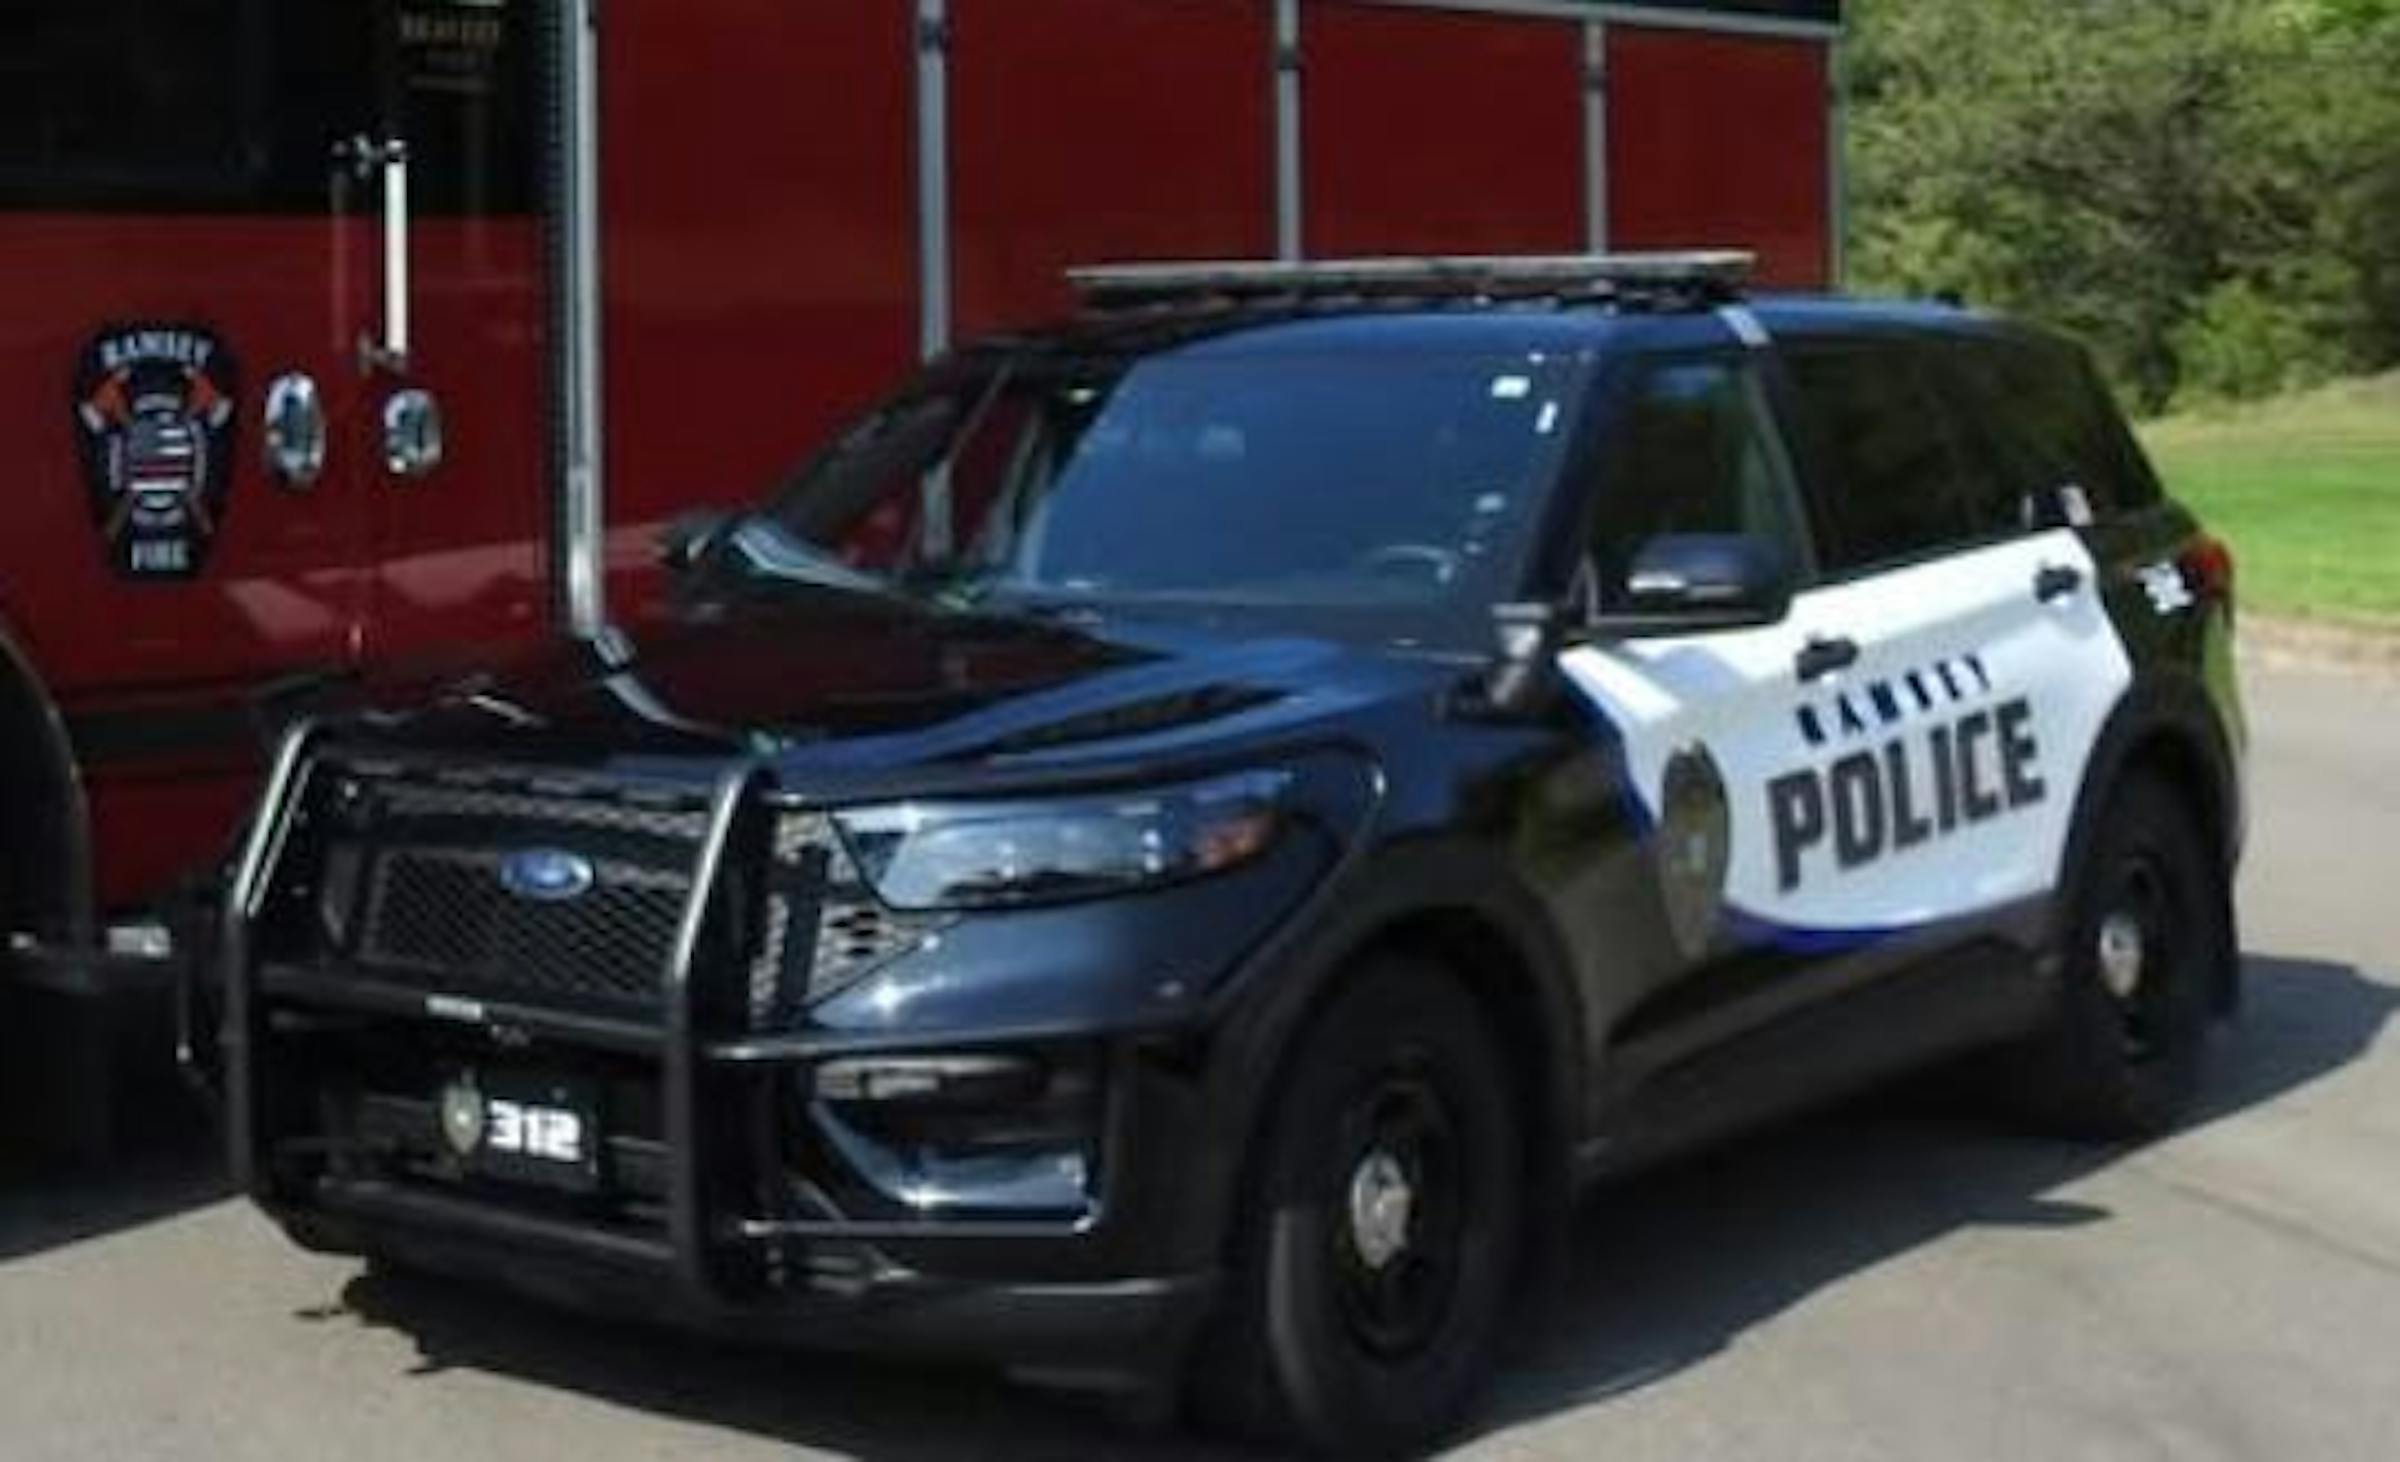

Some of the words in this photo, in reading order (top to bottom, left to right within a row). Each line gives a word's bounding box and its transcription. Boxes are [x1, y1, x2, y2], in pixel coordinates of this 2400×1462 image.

[1796, 653, 1993, 745] RAMSEY
[1766, 698, 2046, 894] POLICE
[487, 1099, 583, 1162] 312
